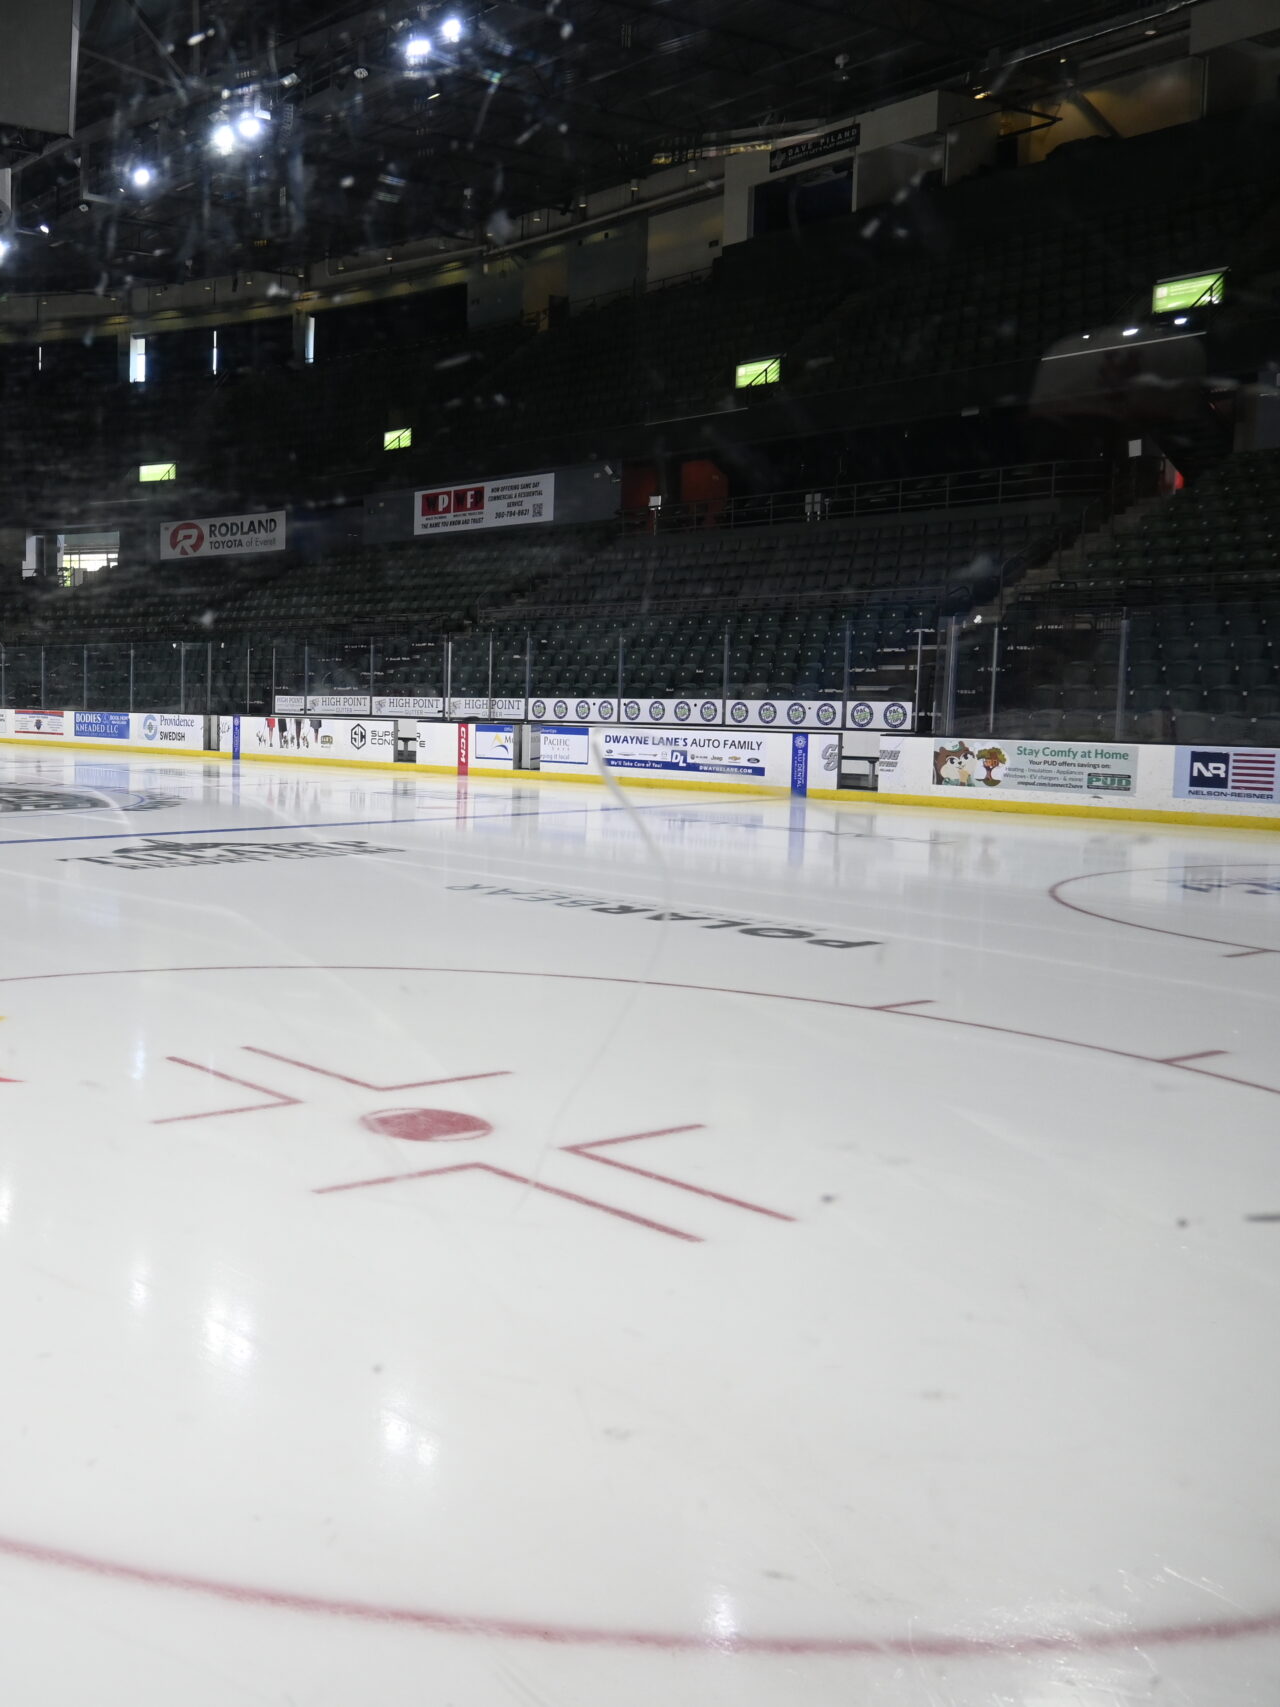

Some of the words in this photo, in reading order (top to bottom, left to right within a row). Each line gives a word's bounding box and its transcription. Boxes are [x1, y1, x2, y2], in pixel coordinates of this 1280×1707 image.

[209, 518, 277, 539] RODLAND
[209, 539, 244, 551] TOYOTA
[321, 697, 341, 706] HIGH
[343, 697, 367, 707] POINT
[389, 698, 410, 708] HIGH
[413, 699, 440, 708] POINT
[464, 699, 488, 709] HIGH
[491, 699, 522, 710] POINT
[76, 713, 101, 723] BODIES
[160, 715, 194, 728] Providence
[76, 723, 105, 733] KNEADED
[107, 725, 118, 733] LLC
[160, 731, 185, 741] SWEDISH
[544, 737, 570, 746] PACIFIC
[605, 735, 649, 745] DWAYNE
[651, 736, 688, 747] LANE'S
[690, 738, 721, 748] AUTO
[723, 739, 762, 751] FAMILY
[1017, 746, 1040, 758] Stay
[1042, 747, 1078, 759] Comfy
[1080, 750, 1092, 759] at
[1094, 749, 1129, 760] Home
[1192, 762, 1226, 778] NR
[1087, 777, 1131, 786] PUD
[1188, 790, 1274, 800] NELSON-REISNER
